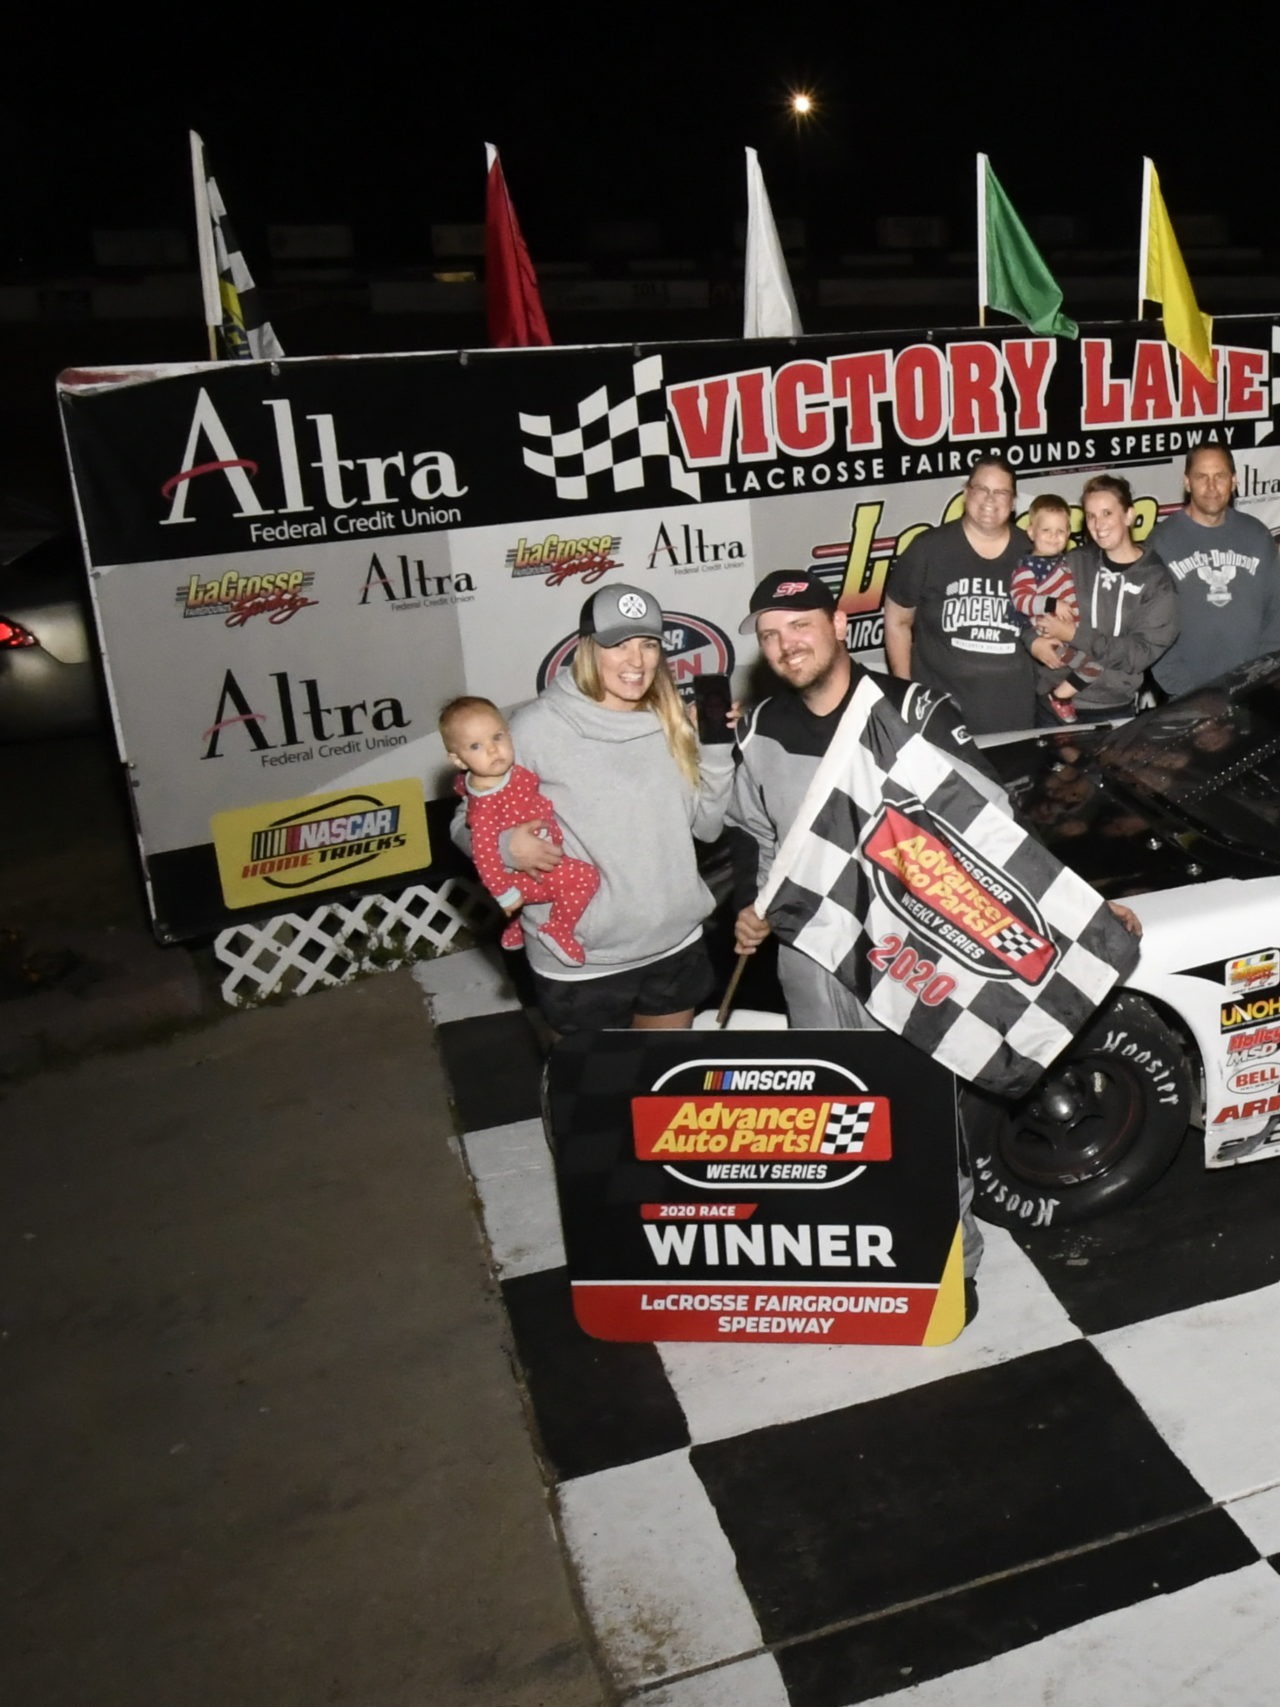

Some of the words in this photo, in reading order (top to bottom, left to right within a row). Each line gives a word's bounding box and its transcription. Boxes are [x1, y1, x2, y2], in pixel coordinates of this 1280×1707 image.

[667, 338, 1057, 467] VICTORY
[1081, 337, 1269, 430] LANE
[159, 387, 468, 525] Altra
[725, 457, 885, 494] LACROSSE
[901, 438, 1096, 477] FAIRGOUNDS
[1110, 426, 1236, 457] SPEEDWAY
[250, 515, 328, 543] Federal
[333, 510, 395, 536] Credit
[400, 504, 462, 529] Union
[516, 534, 612, 566] LaCrosse
[646, 520, 746, 570] Altra
[358, 552, 477, 605] Altra
[674, 565, 699, 577] Federal
[701, 563, 722, 573] Credit
[724, 560, 745, 571] Union
[958, 577, 1008, 597] DELL
[186, 570, 303, 607] LaCrosse
[391, 599, 421, 612] Federal
[423, 597, 448, 609] Credit
[450, 594, 476, 606] Union
[942, 596, 1012, 632] RACEW
[970, 627, 1001, 642] PARK
[200, 668, 411, 760] Altra
[261, 747, 314, 769] Federal
[318, 740, 362, 761] Credit
[365, 732, 408, 752] Union
[298, 808, 394, 852] NASCAR
[241, 852, 314, 879] HOME
[318, 832, 408, 864] TRACKS
[878, 846, 929, 890] Auto
[925, 881, 990, 935] Parts
[897, 834, 1000, 922] Advance
[955, 850, 1014, 905] NASCAR
[901, 893, 940, 938] WEEKLY
[937, 922, 986, 962] SERIES
[867, 932, 957, 1007] 2020
[731, 1071, 816, 1091] NASCAR
[1236, 1067, 1280, 1088] BELL
[667, 1102, 816, 1131] Advance
[651, 1130, 728, 1154] Auto
[730, 1130, 810, 1154] Parts
[706, 1164, 770, 1180] WEEKLY
[770, 1164, 828, 1180] SERIES
[659, 1206, 696, 1217] 2020
[700, 1206, 736, 1217] RACE
[642, 1223, 897, 1268] WINNER
[640, 1293, 748, 1312] LaCROSSE
[754, 1294, 909, 1314] FAIRGROUNDS
[717, 1316, 835, 1334] SPEEDWAY
